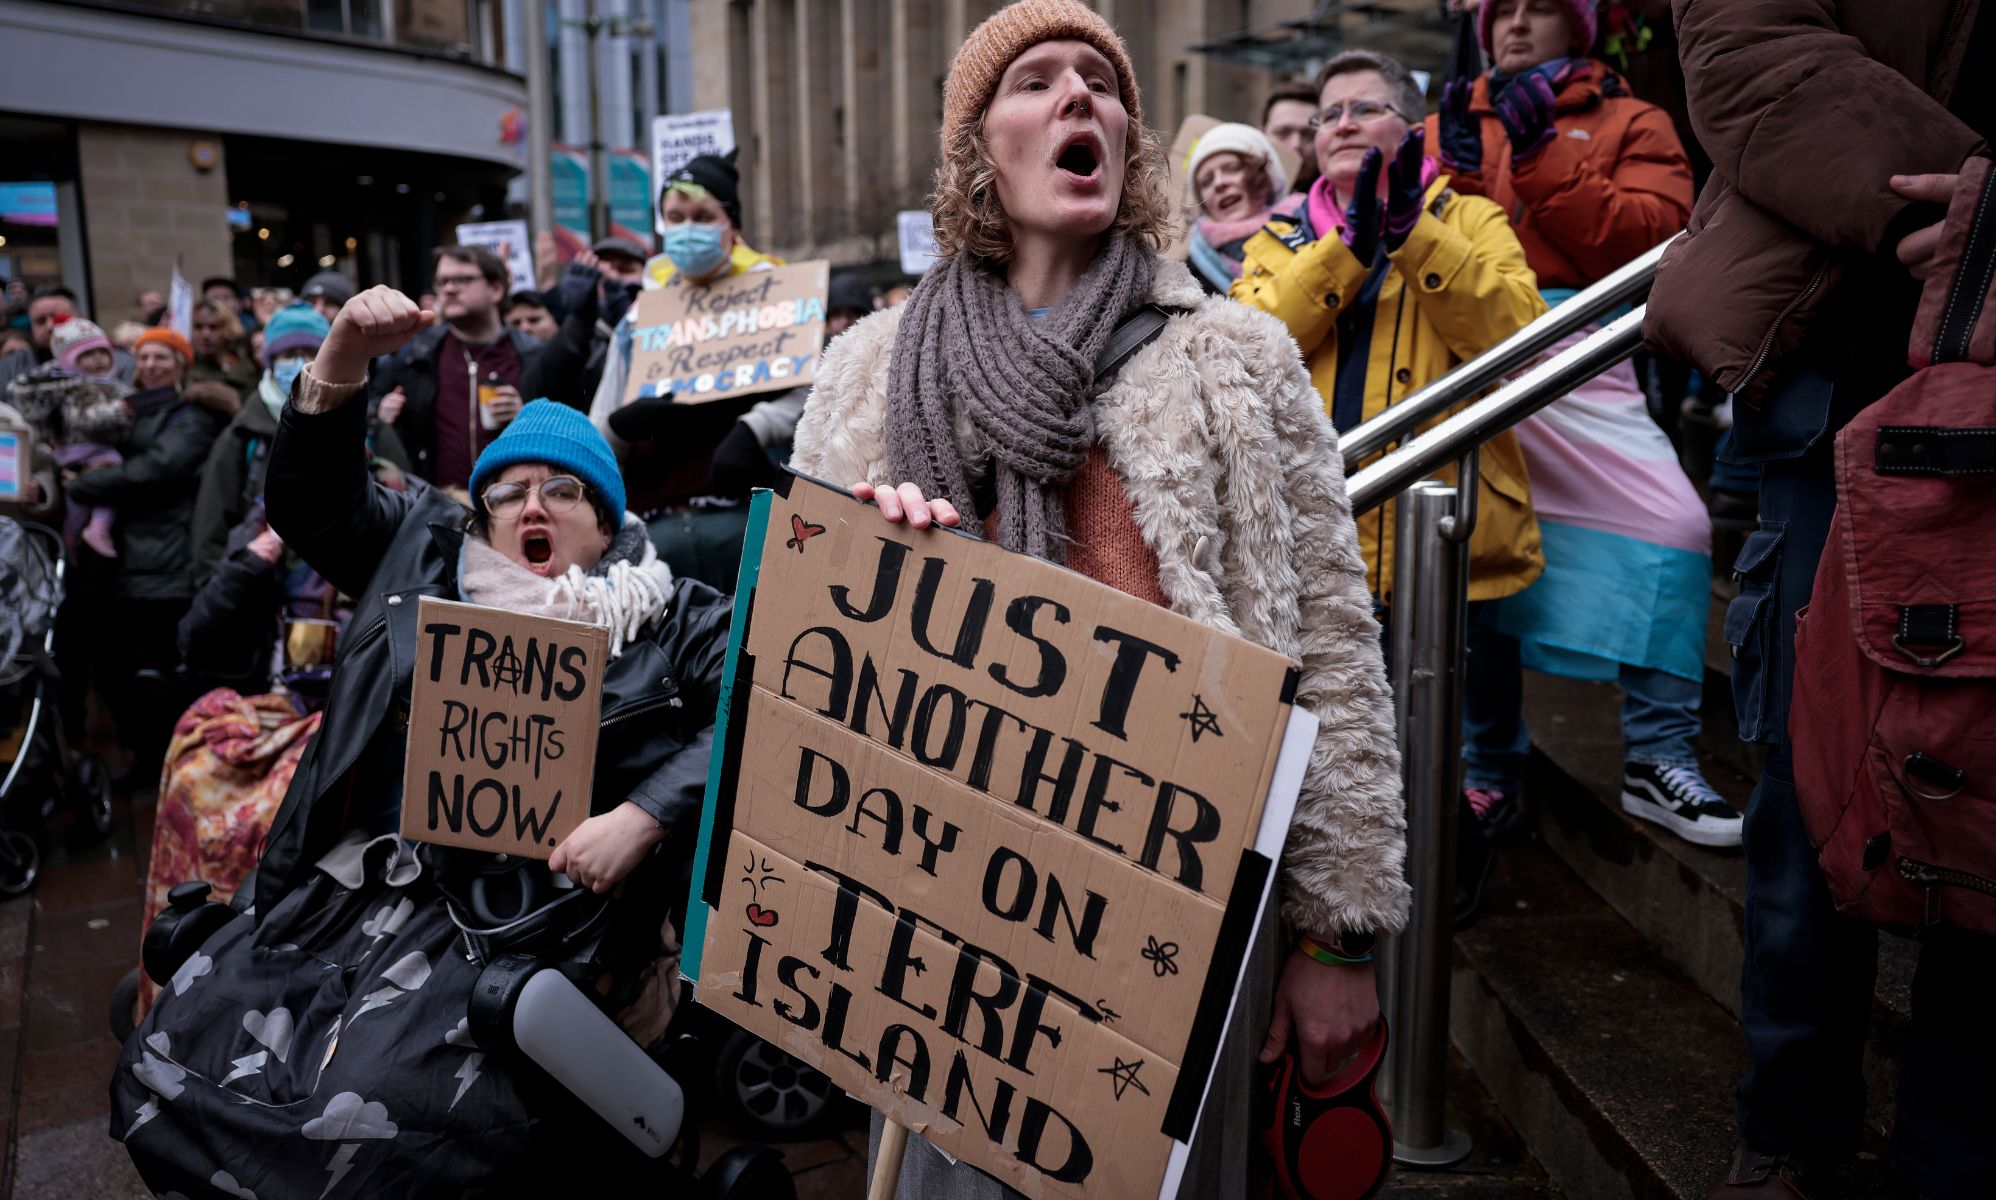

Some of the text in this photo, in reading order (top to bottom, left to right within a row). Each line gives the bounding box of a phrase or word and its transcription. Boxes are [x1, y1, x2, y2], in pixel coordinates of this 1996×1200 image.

[631, 297, 826, 352] TRANSPHOBIA
[680, 275, 782, 315] Reject
[638, 354, 812, 398] DEMOCRACY
[668, 331, 796, 375] Respect
[425, 623, 587, 702] TRANS
[828, 535, 1181, 741] JUST
[439, 700, 565, 779] RIGHTS
[781, 626, 1222, 892] ANOTHER
[427, 771, 562, 847] NOW.
[793, 746, 1109, 961] DAY ON
[803, 859, 1102, 1076] TERF
[732, 929, 1095, 1184] ISLAND
